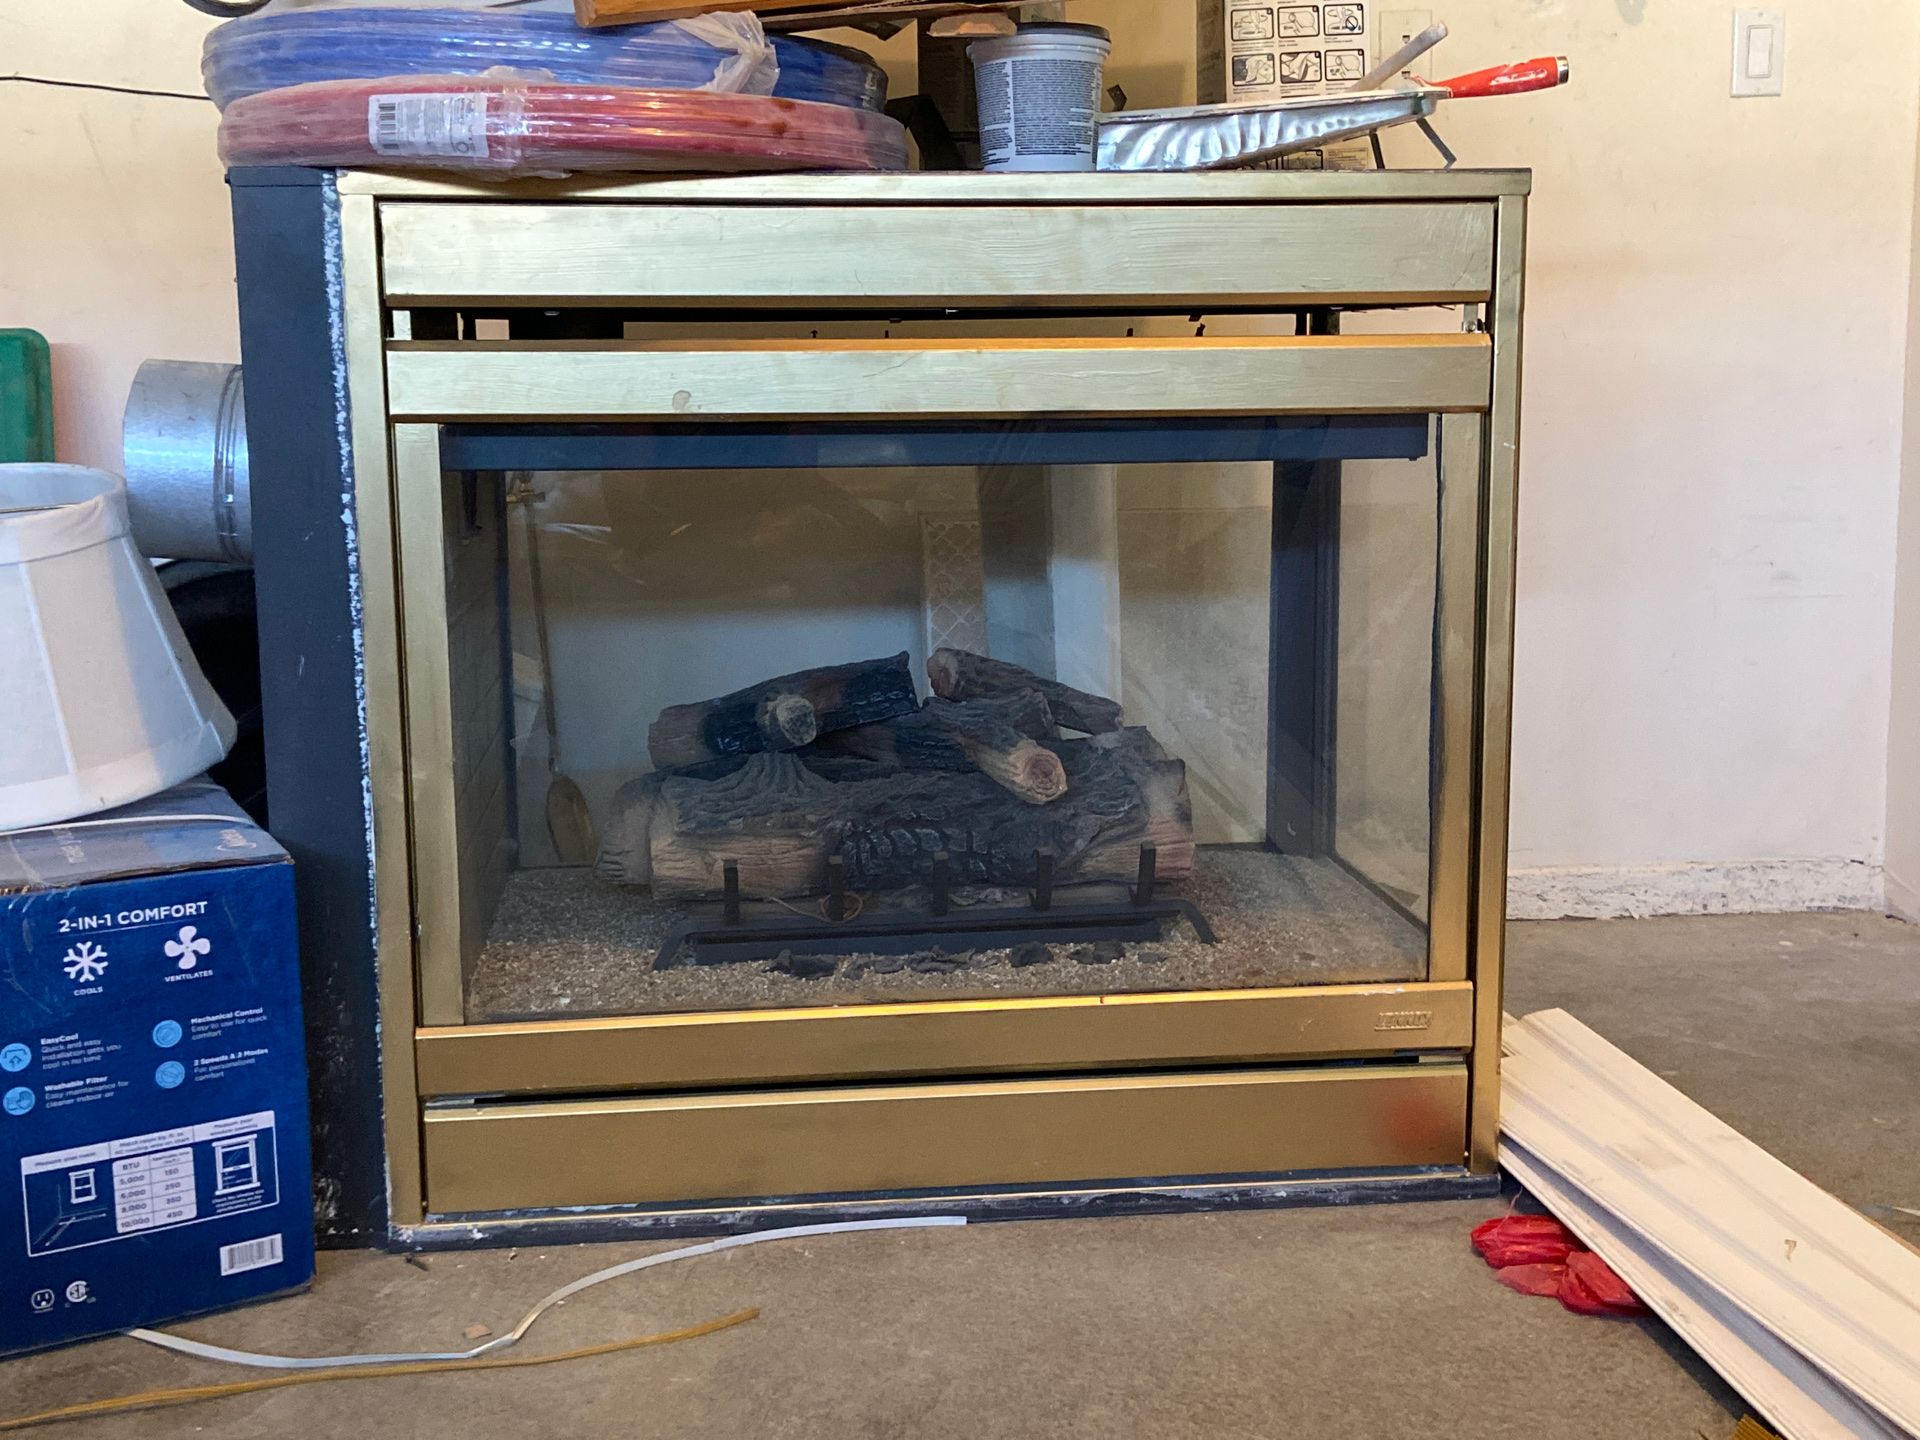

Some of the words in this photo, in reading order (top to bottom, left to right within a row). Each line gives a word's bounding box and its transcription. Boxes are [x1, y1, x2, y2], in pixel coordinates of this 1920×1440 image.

[59, 914, 112, 933] 2-IN-1
[117, 901, 208, 925] COMFORT
[164, 969, 214, 982] VENTILATES
[73, 986, 104, 996] COOLS
